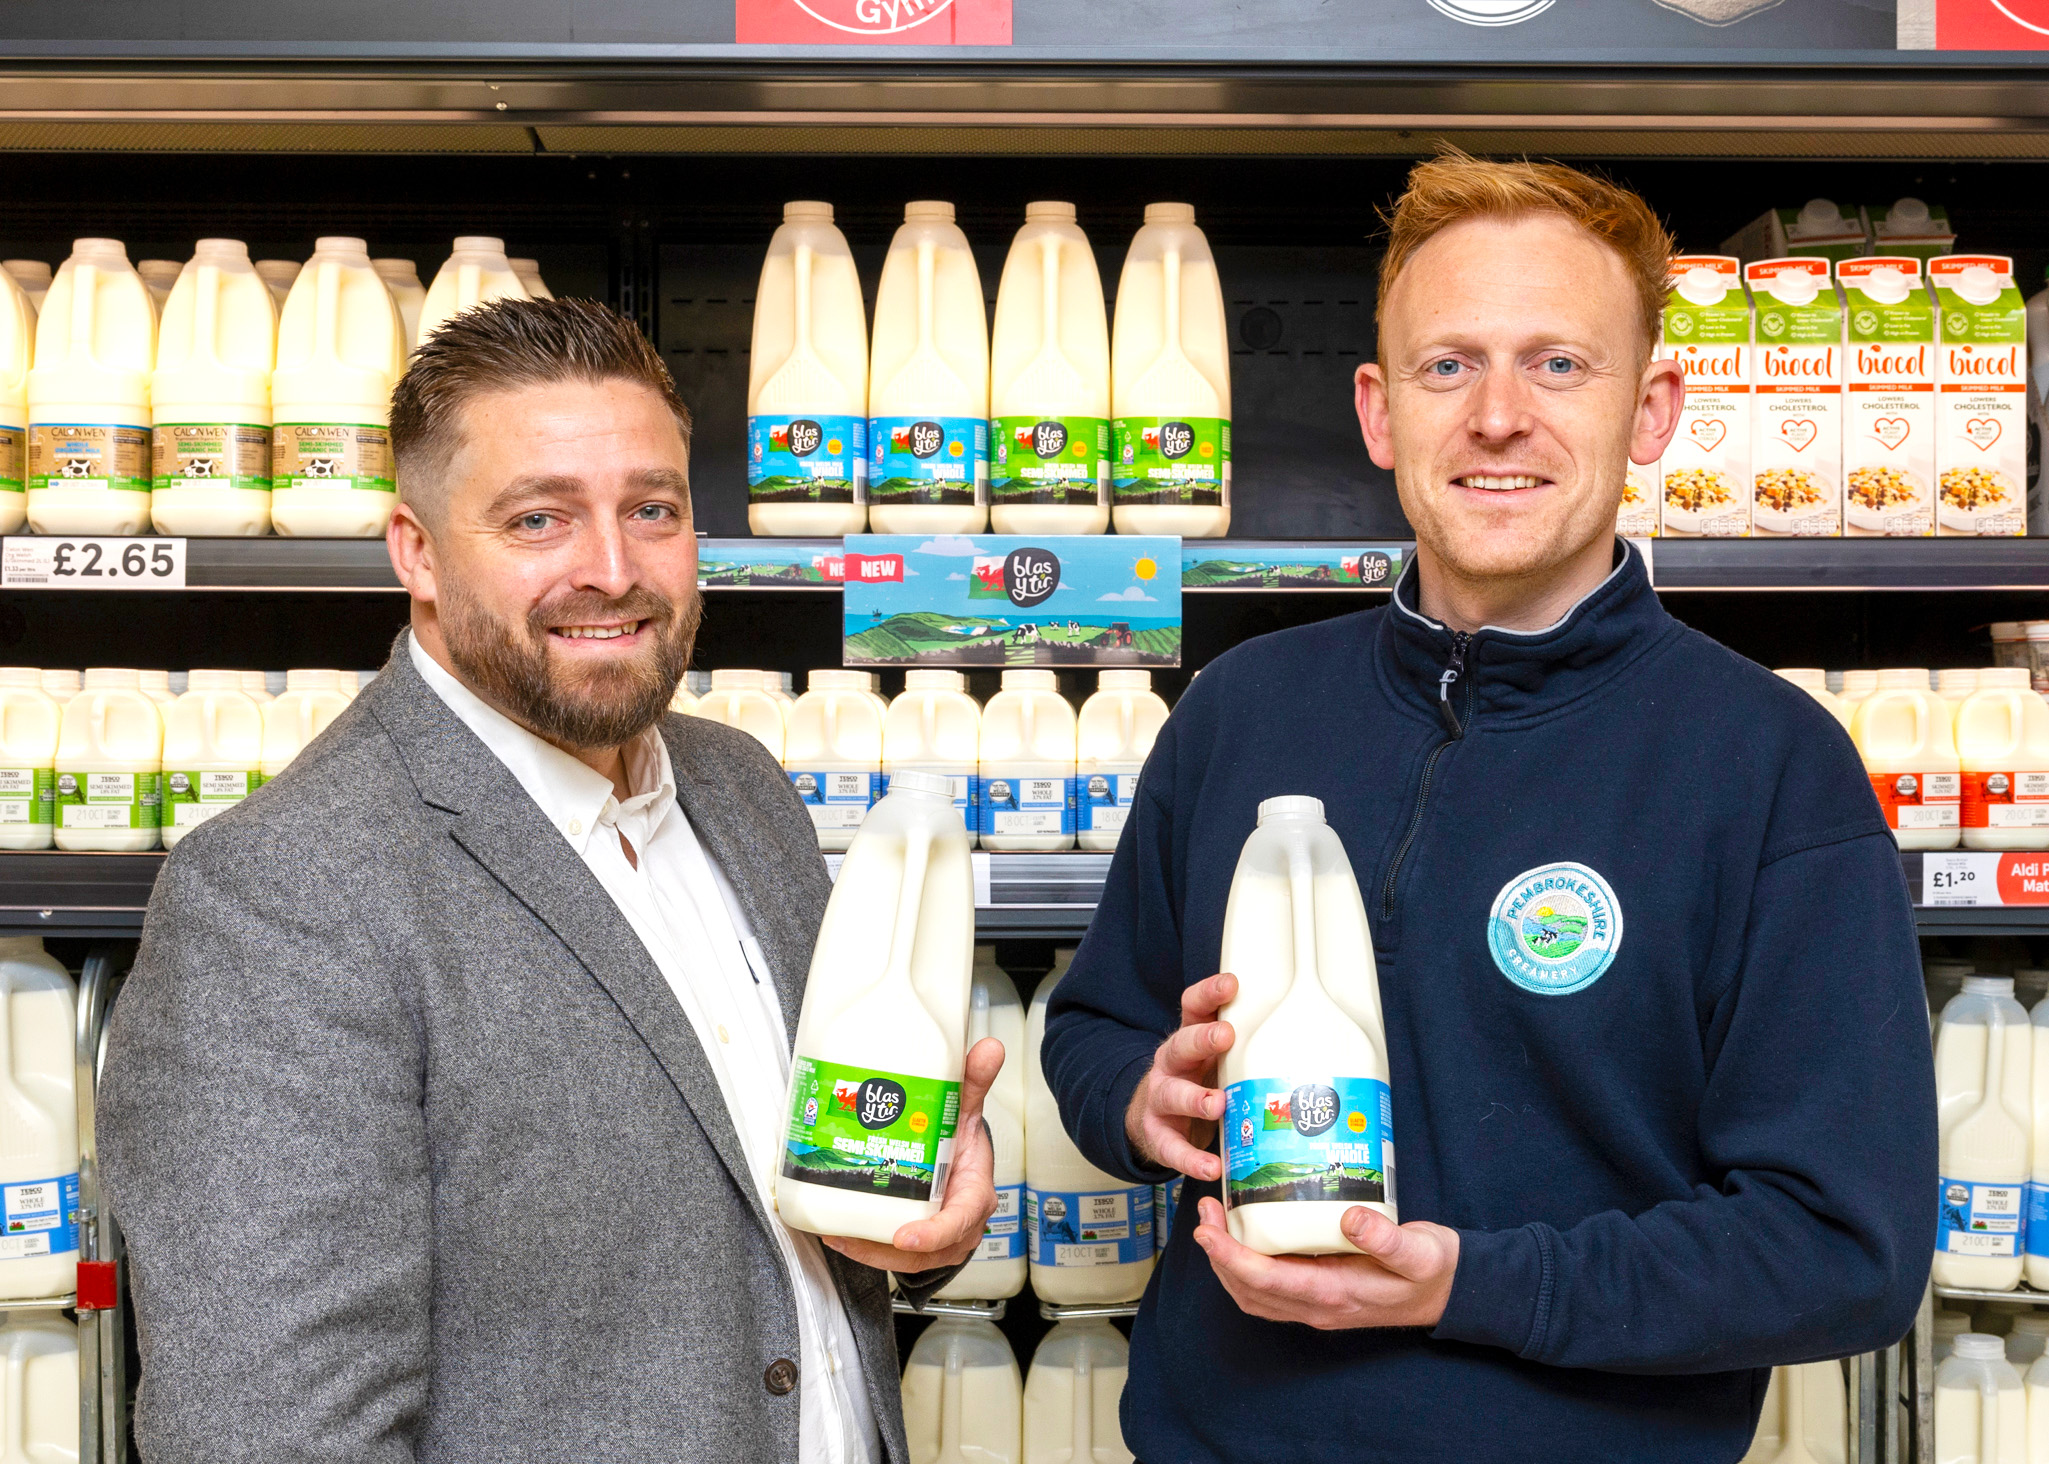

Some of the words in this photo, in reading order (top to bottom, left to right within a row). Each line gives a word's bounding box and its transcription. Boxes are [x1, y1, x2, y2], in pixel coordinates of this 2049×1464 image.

[1674, 346, 1741, 378] biocol
[1765, 346, 1832, 379] biocol
[1858, 345, 1925, 376] biocol
[1950, 345, 2017, 378] biocol
[84, 428, 106, 437] WEN
[206, 428, 228, 436] WEN
[328, 428, 350, 437] WEN
[793, 424, 818, 439] blas
[914, 426, 940, 440] blas
[1038, 426, 1063, 440] blas
[1165, 426, 1190, 440] blas
[811, 466, 844, 477] WHOLE
[932, 468, 965, 479] WHOLE
[1020, 468, 1088, 479] SEMI-SKIMMED
[1148, 468, 1214, 479] SEMI-SKIMMED
[53, 543, 174, 577] £2.65
[1013, 556, 1052, 577] blas
[1363, 556, 1387, 569] blas
[829, 563, 844, 577] NE
[861, 561, 896, 577] NEW
[2011, 863, 2038, 876] Aldi
[1933, 872, 1976, 888] £1.20
[1507, 877, 1607, 941] PEMBROKESHIRE
[1508, 949, 1578, 979] CREAMERY
[866, 1084, 899, 1104] blas
[1298, 1091, 1333, 1109] blas
[832, 1136, 925, 1163] SEMI-SKIMMED
[867, 1136, 888, 1146] FRESH
[889, 1138, 910, 1148] WELSH
[911, 1142, 925, 1151] MILK
[1326, 1149, 1370, 1164] WHOLE
[20, 1187, 43, 1196] TESCO
[1988, 1189, 2008, 1198] TESCO
[1093, 1198, 1114, 1206] TESCO
